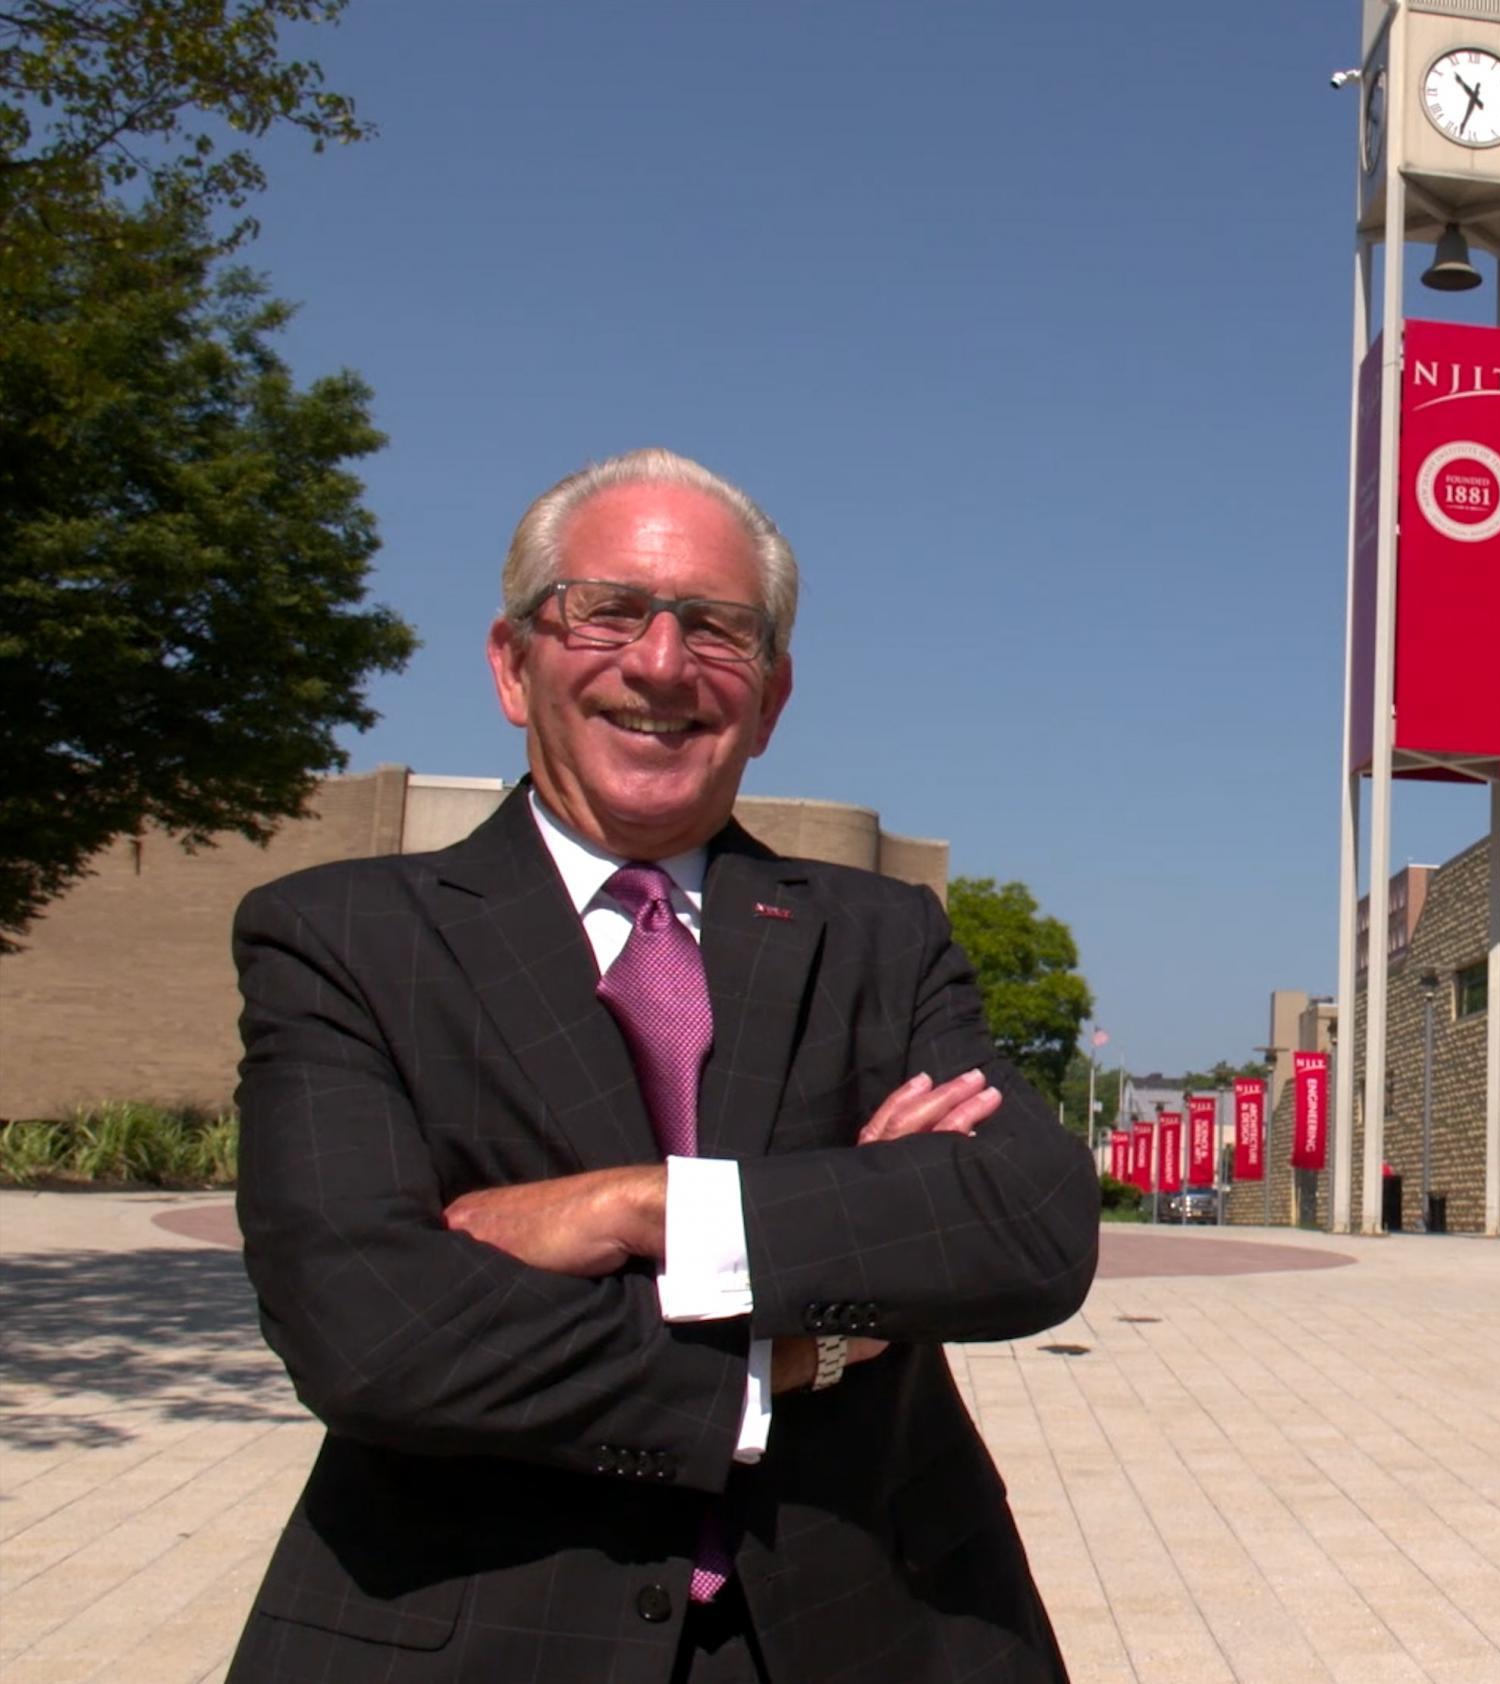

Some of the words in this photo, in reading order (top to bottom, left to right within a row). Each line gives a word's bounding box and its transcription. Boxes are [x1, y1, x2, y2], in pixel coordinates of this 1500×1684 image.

[1446, 475, 1490, 486] FOUNDED
[1445, 485, 1491, 505] 1881
[1296, 1058, 1325, 1069] NJIT
[1306, 1078, 1318, 1152] ENGINEERING
